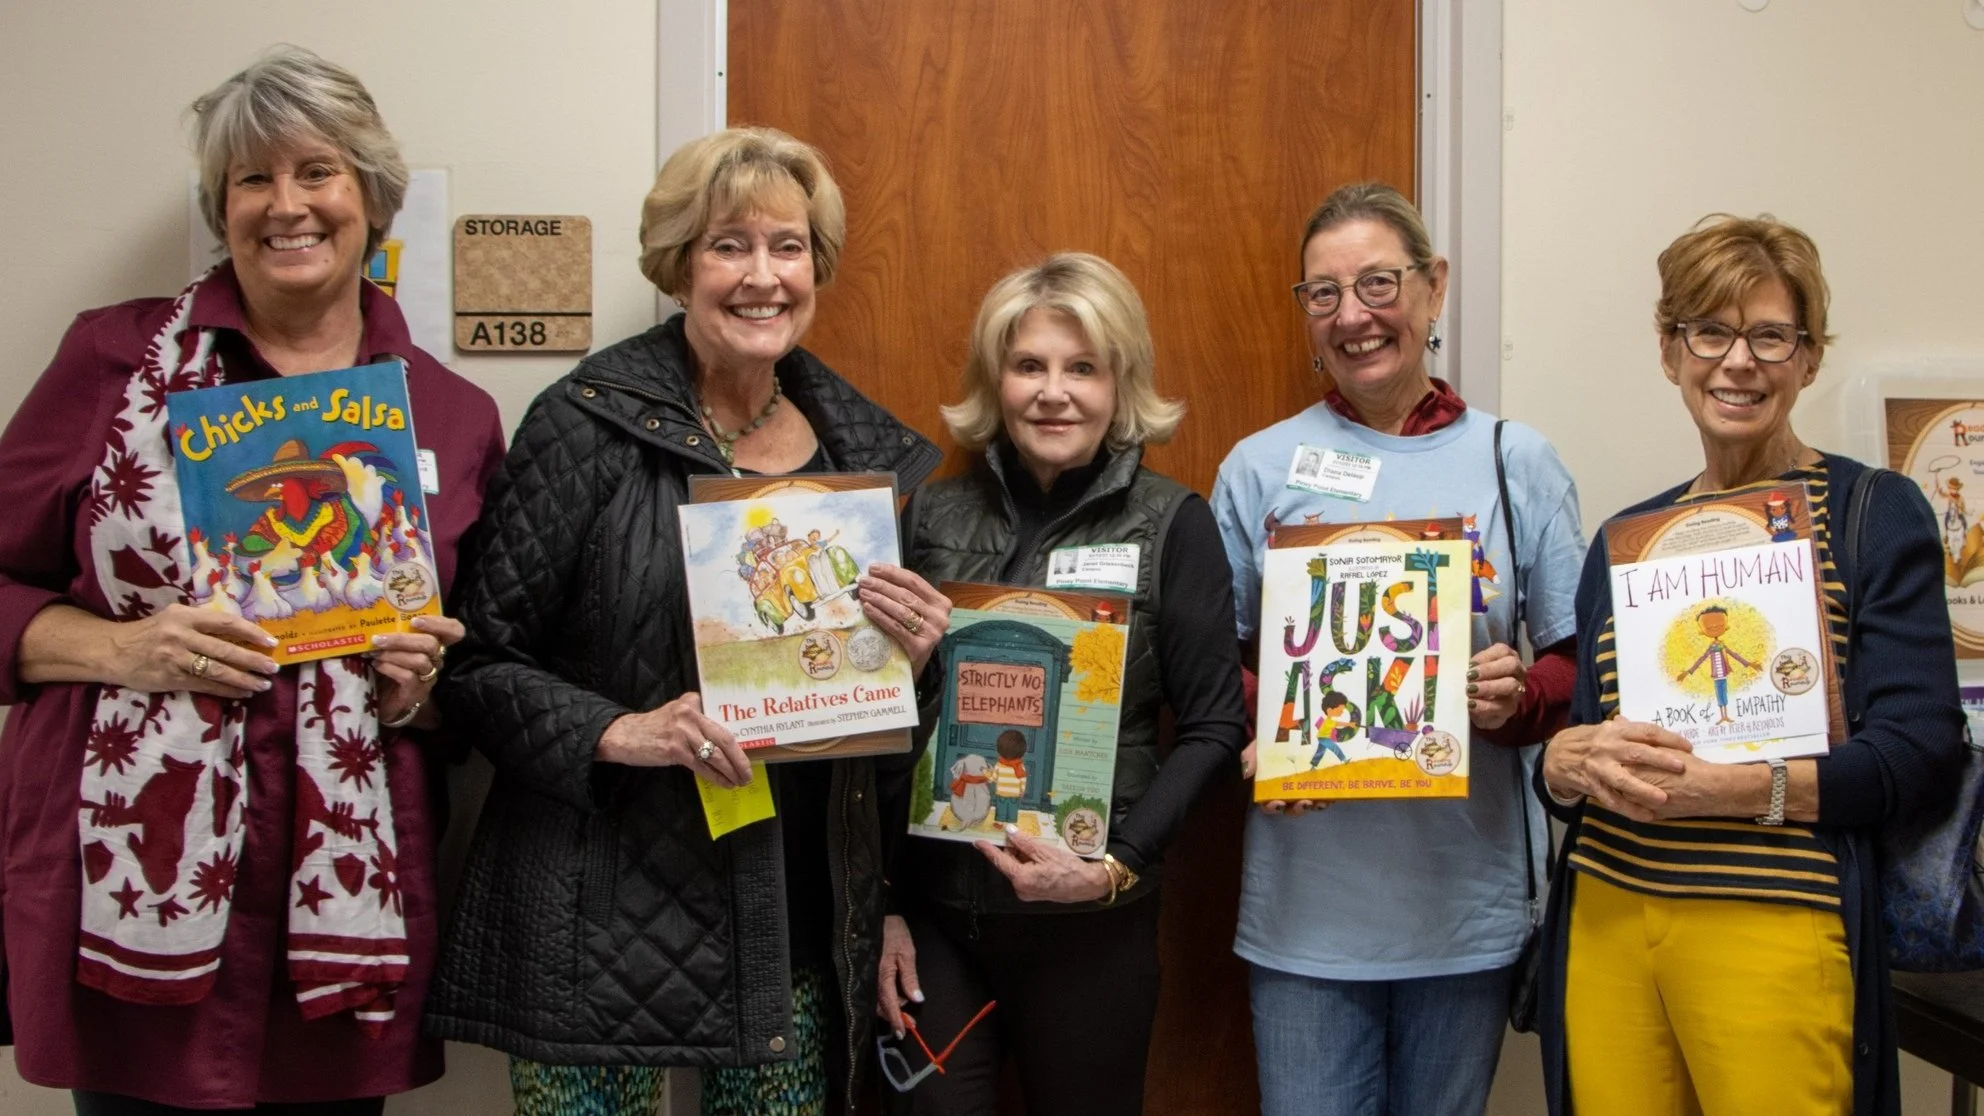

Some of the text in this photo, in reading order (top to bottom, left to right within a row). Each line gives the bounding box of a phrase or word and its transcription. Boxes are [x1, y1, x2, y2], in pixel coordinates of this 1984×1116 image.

[465, 220, 562, 236] STORAGE
[470, 321, 547, 346] A138
[179, 388, 406, 462] Chicks and Salsa
[1336, 453, 1372, 466] VISITOR
[1330, 487, 1363, 499] Elementary
[1329, 554, 1403, 566] SONIA SOTOMAYOR
[1093, 579, 1129, 589] Elementary
[1339, 571, 1364, 580] RAFAEL
[1619, 546, 1803, 608] I AM HUMAN
[1284, 551, 1450, 658] JUST
[1947, 595, 1968, 605] ooks
[360, 615, 396, 627] Paulette
[296, 635, 365, 651] SCHOLASTIC
[960, 669, 1041, 690] STRICTLY NO
[718, 684, 901, 722] The Relatives Came
[961, 694, 1040, 714] ELEPHANTS
[1275, 654, 1440, 746] ASK!
[1652, 693, 1787, 728] A BOOK of EMPATHY
[740, 723, 775, 738] CYNTHIA
[775, 718, 805, 732] RYLANT
[837, 709, 870, 723] STEPHEN
[870, 704, 908, 718] GAMMELL
[1752, 716, 1786, 733] REYNOLDS
[1282, 781, 1295, 791] BE
[1347, 780, 1361, 790] BE
[1399, 779, 1412, 789] BE
[1415, 778, 1432, 789] YOU
